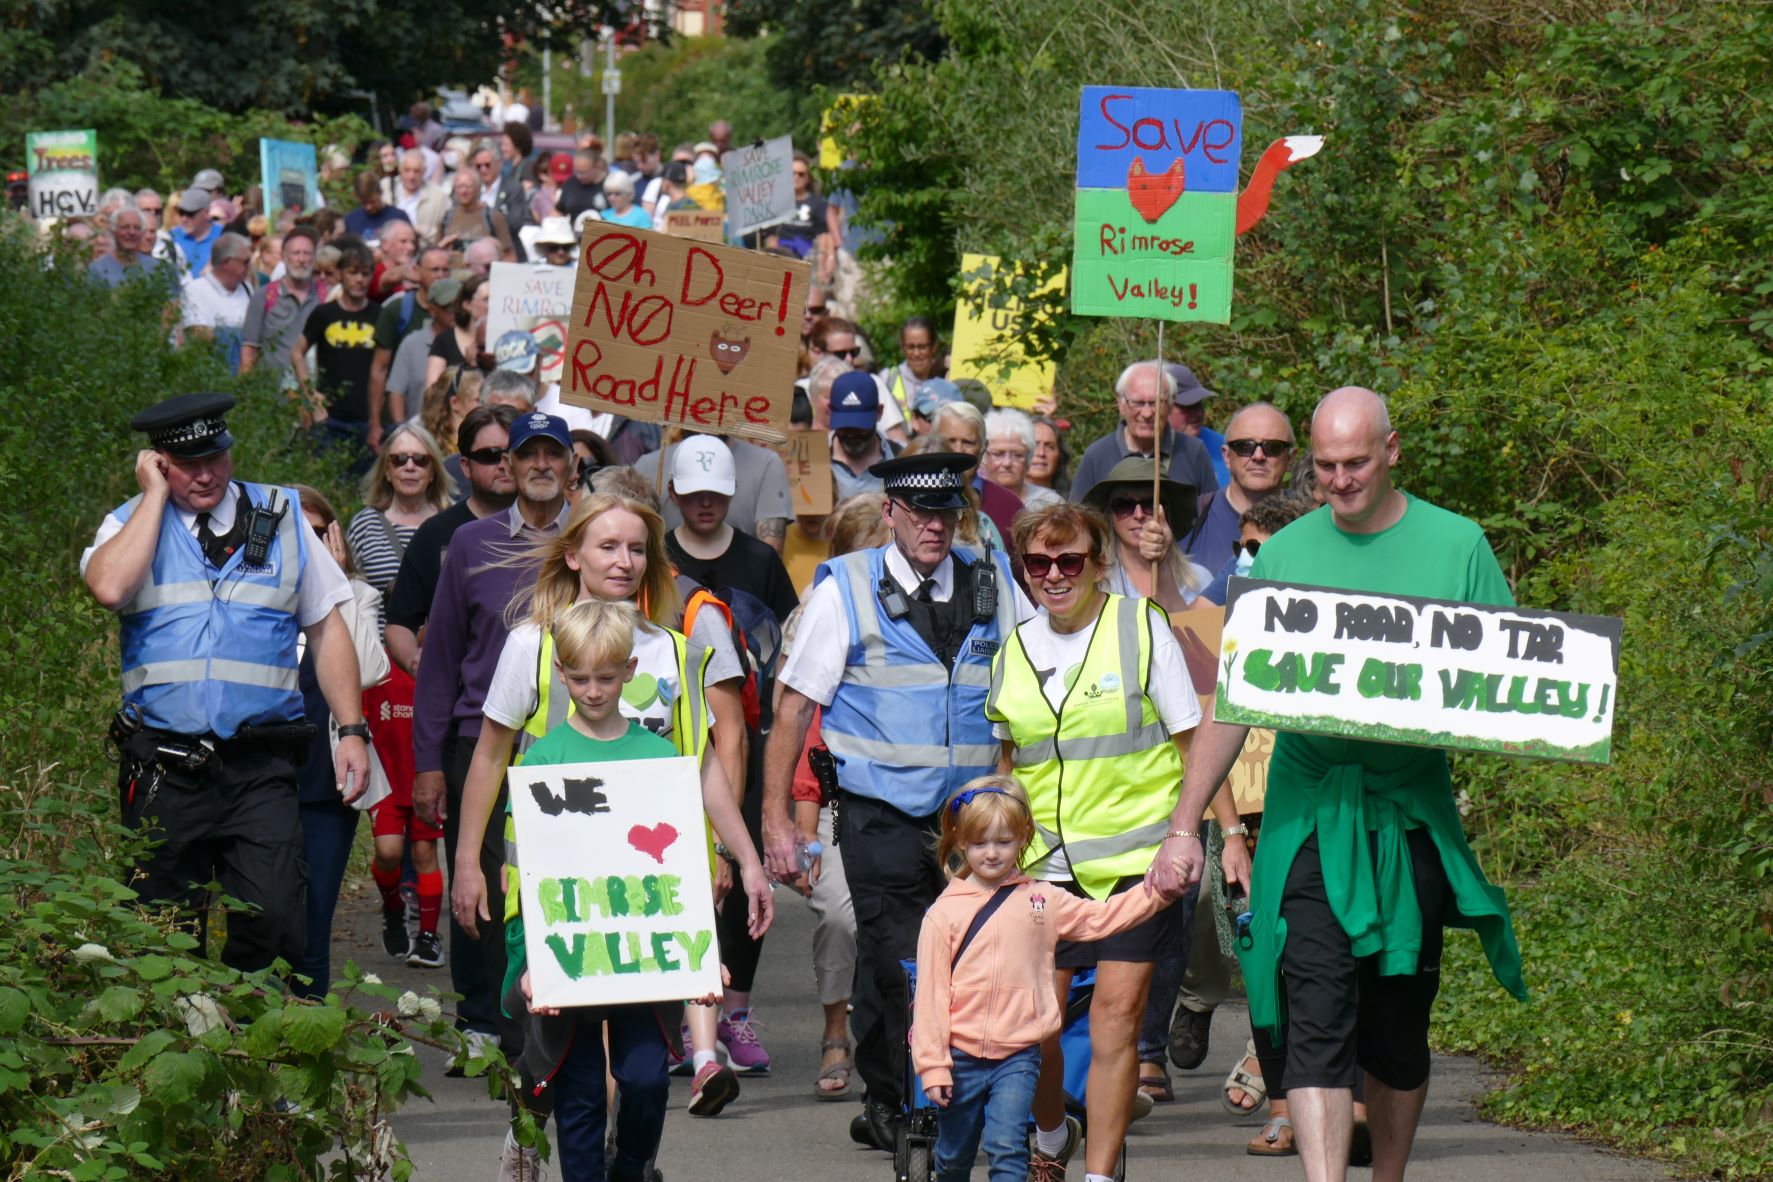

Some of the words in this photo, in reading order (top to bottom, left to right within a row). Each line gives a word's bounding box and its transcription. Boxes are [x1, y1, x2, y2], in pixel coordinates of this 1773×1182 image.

[1094, 94, 1234, 164] Save
[32, 147, 92, 172] Trees
[1101, 223, 1195, 257] Rimrose
[522, 279, 565, 296] SAVE
[681, 247, 793, 337] Deer!
[1107, 273, 1198, 311] Valley!
[572, 339, 664, 407] Road
[665, 354, 771, 427] Here
[1264, 596, 1319, 634] NO
[1430, 611, 1484, 651] NO
[1499, 618, 1565, 665] TAR
[1243, 648, 1345, 696] SAVE
[1357, 657, 1423, 701] OUR
[529, 777, 611, 817] WE
[538, 873, 684, 926] RIMROSE
[545, 929, 712, 981] VALLEY
